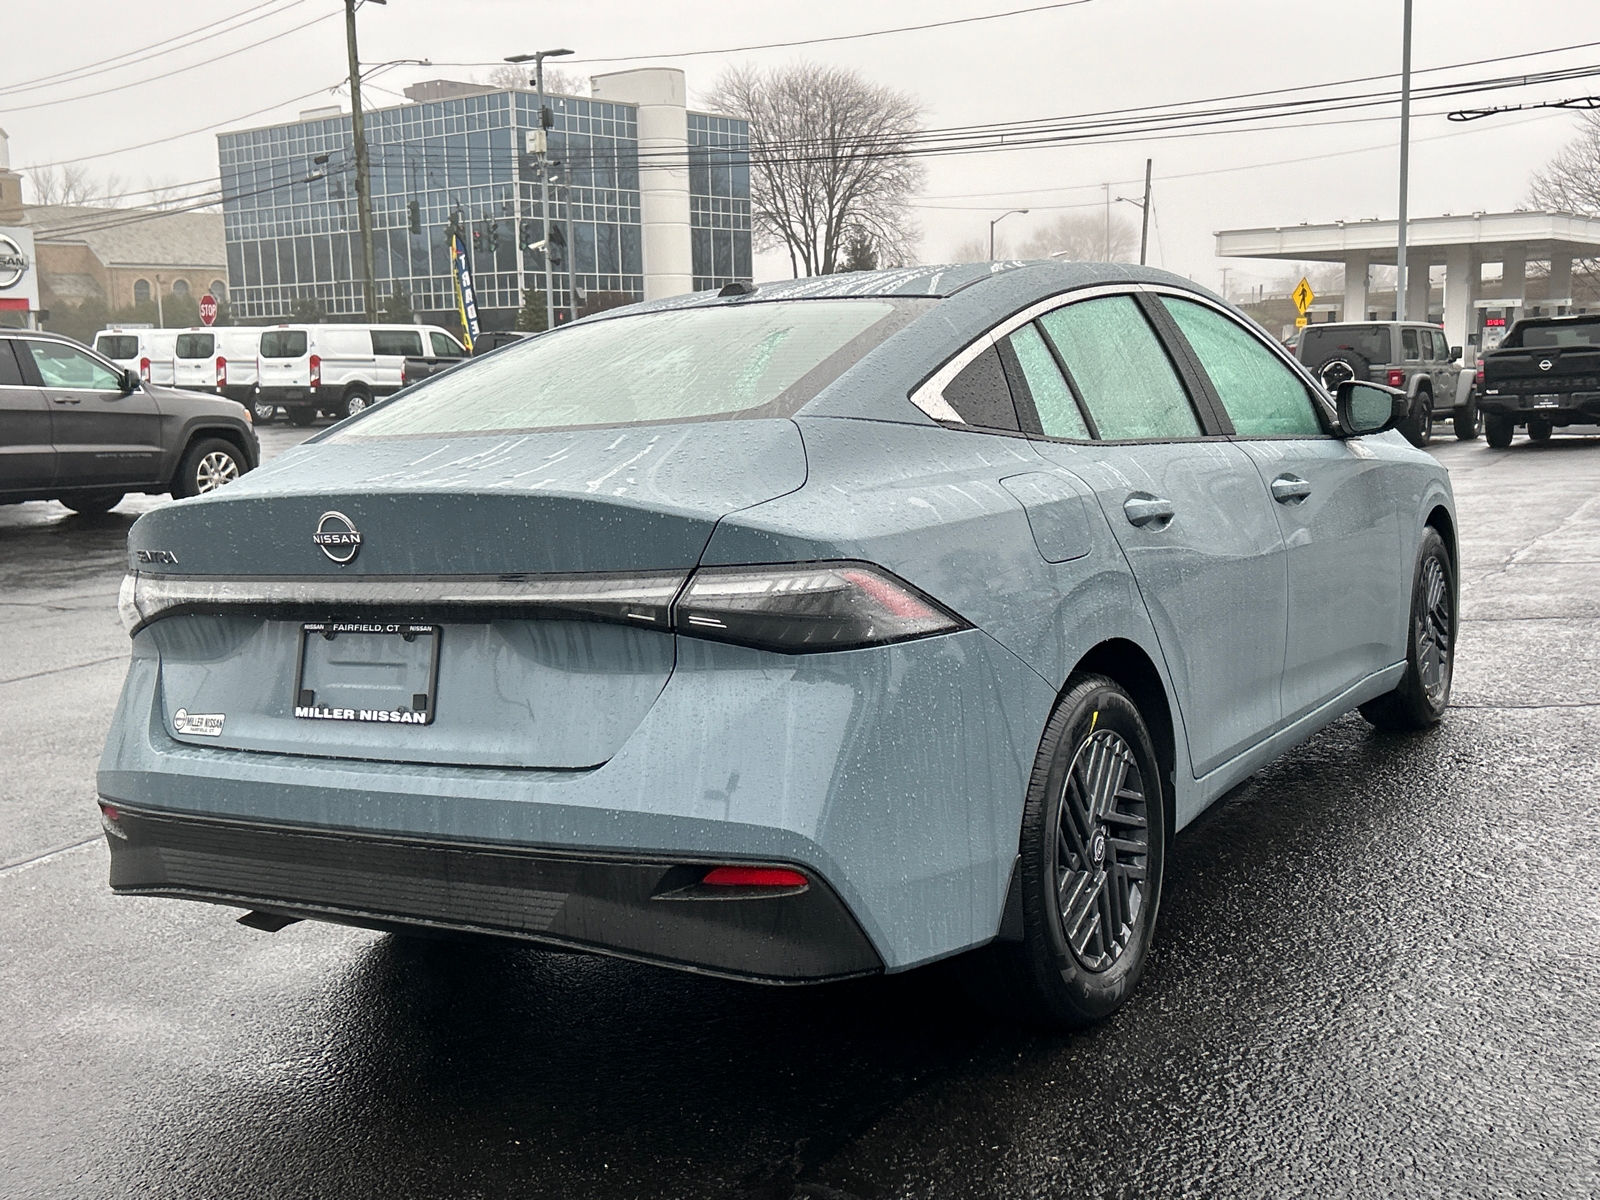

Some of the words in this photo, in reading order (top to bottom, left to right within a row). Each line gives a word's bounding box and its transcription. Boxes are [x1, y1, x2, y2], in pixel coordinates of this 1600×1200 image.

[200, 304, 217, 317] STOP
[312, 534, 361, 544] NISSAN
[332, 623, 384, 633] FAIRFIELD,
[386, 624, 400, 632] CT
[295, 707, 355, 720] MILLER
[359, 710, 426, 724] NISSAN
[186, 717, 204, 727] MILLER
